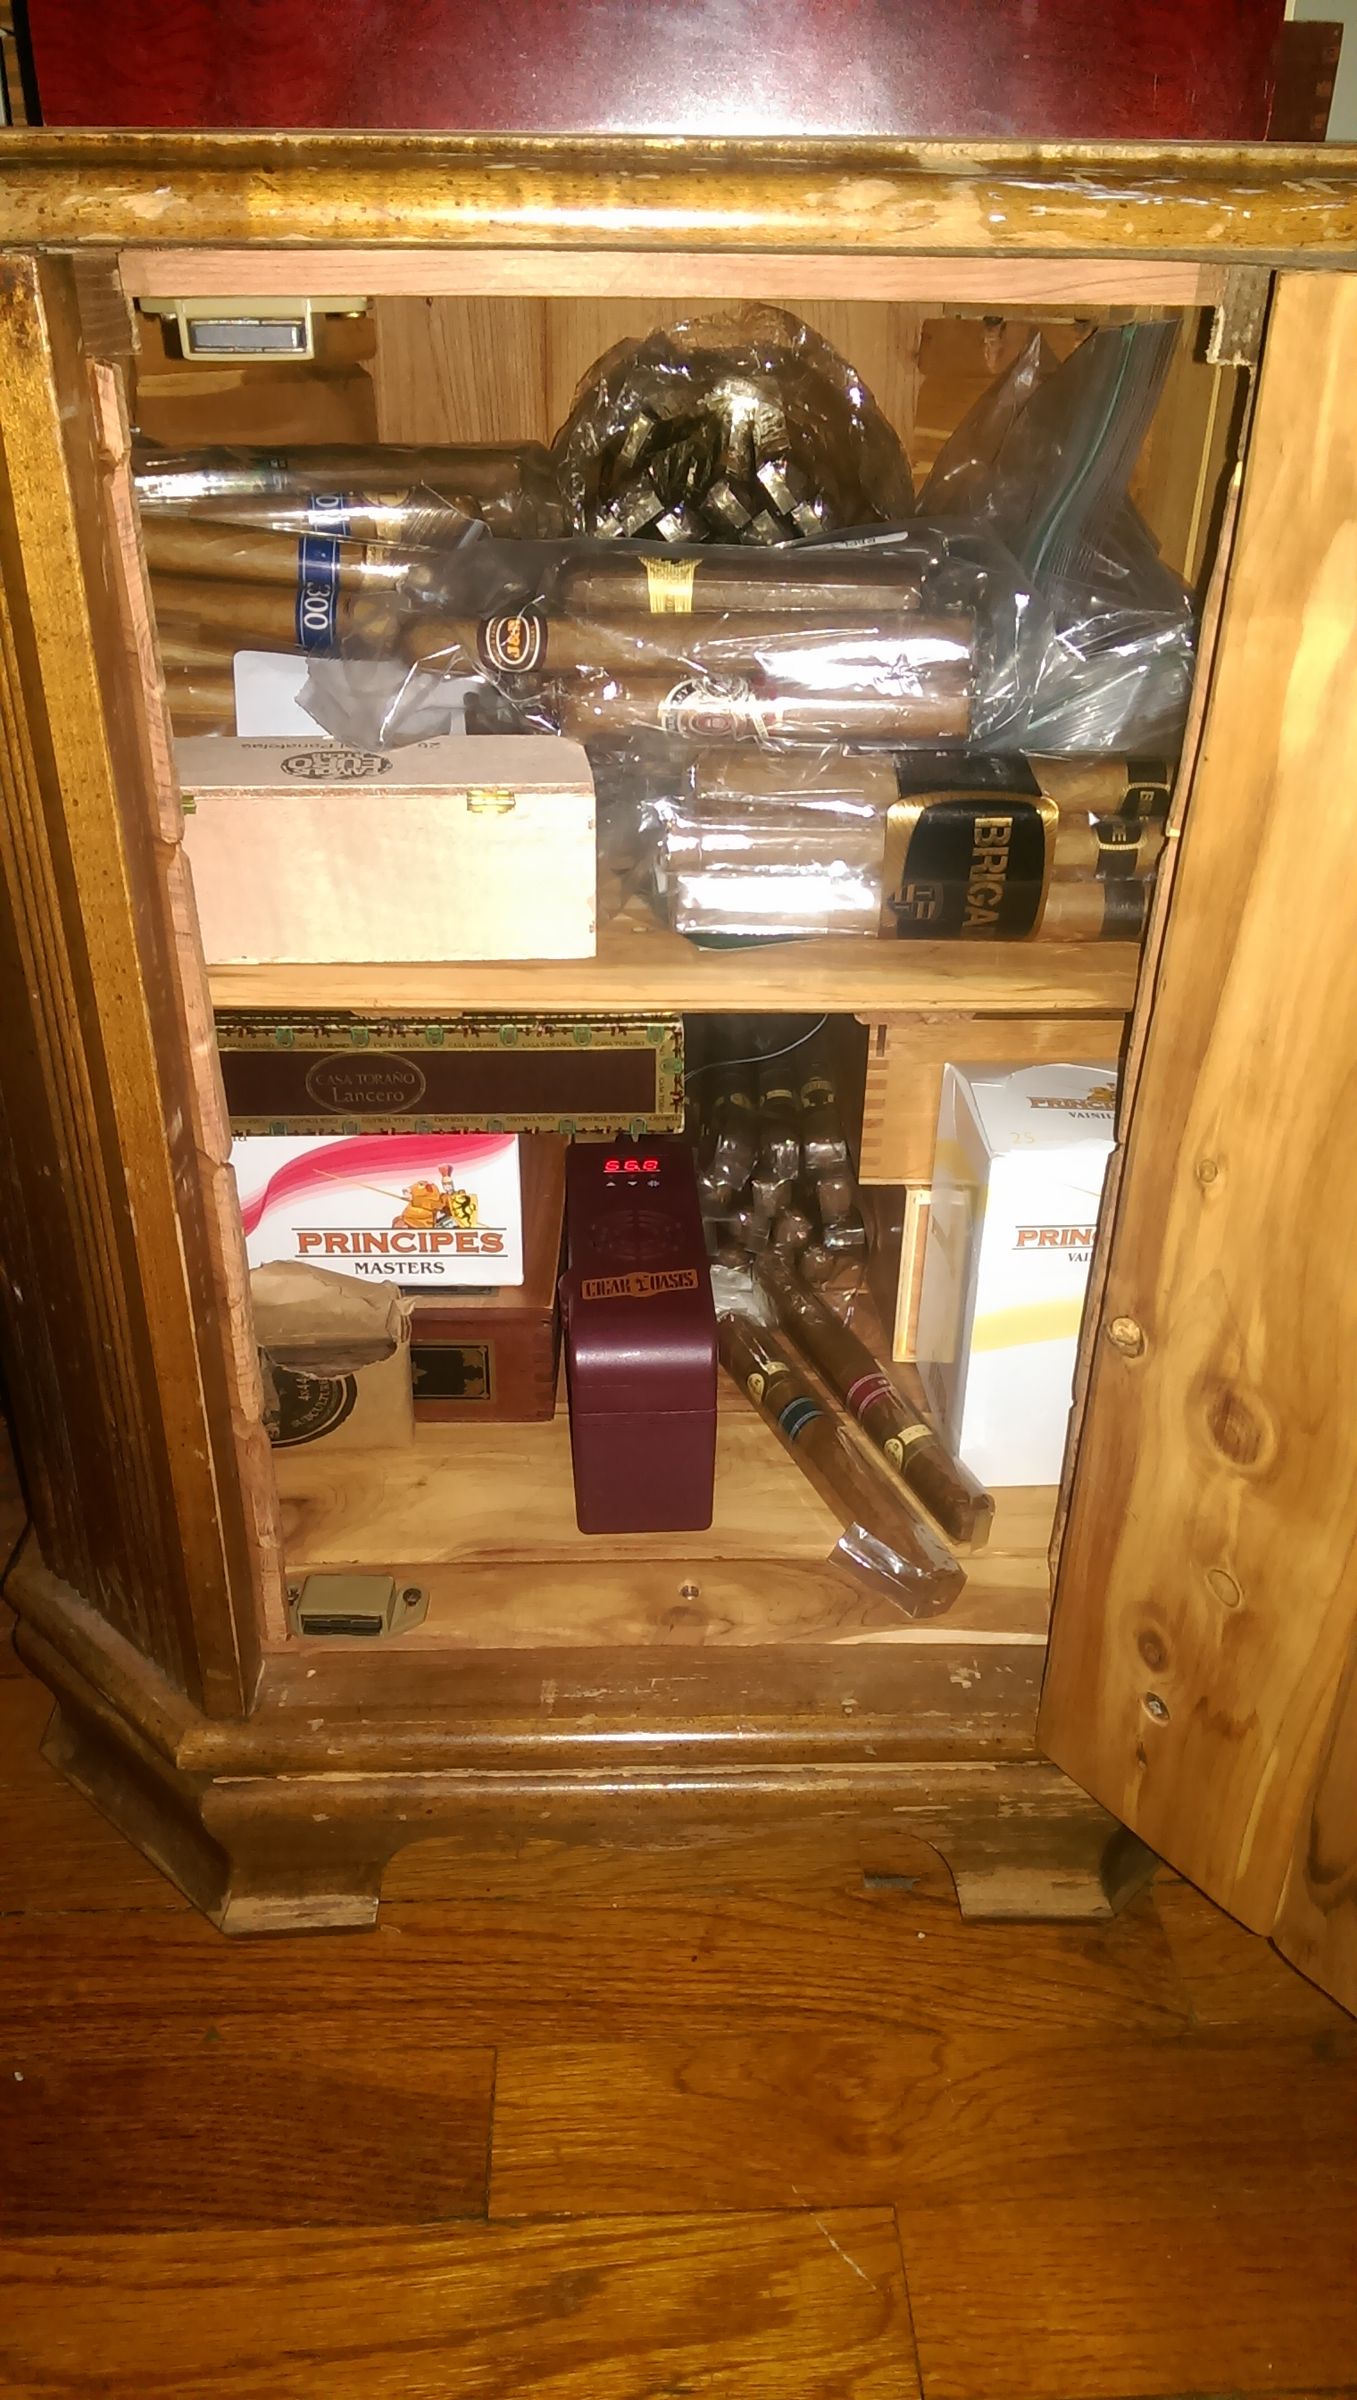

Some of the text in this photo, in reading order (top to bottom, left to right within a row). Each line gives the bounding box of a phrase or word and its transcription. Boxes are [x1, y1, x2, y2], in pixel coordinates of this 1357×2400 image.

[303, 582, 331, 630] 300
[287, 755, 382, 775] EURO
[316, 1070, 416, 1085] CASA TORAÑO
[332, 1087, 405, 1102] Lancero
[296, 1232, 505, 1254] PRINCIPES
[1016, 1229, 1097, 1247] PRIN
[354, 1261, 445, 1275] MASTERS
[585, 1271, 694, 1297] CIGAR OASIS
